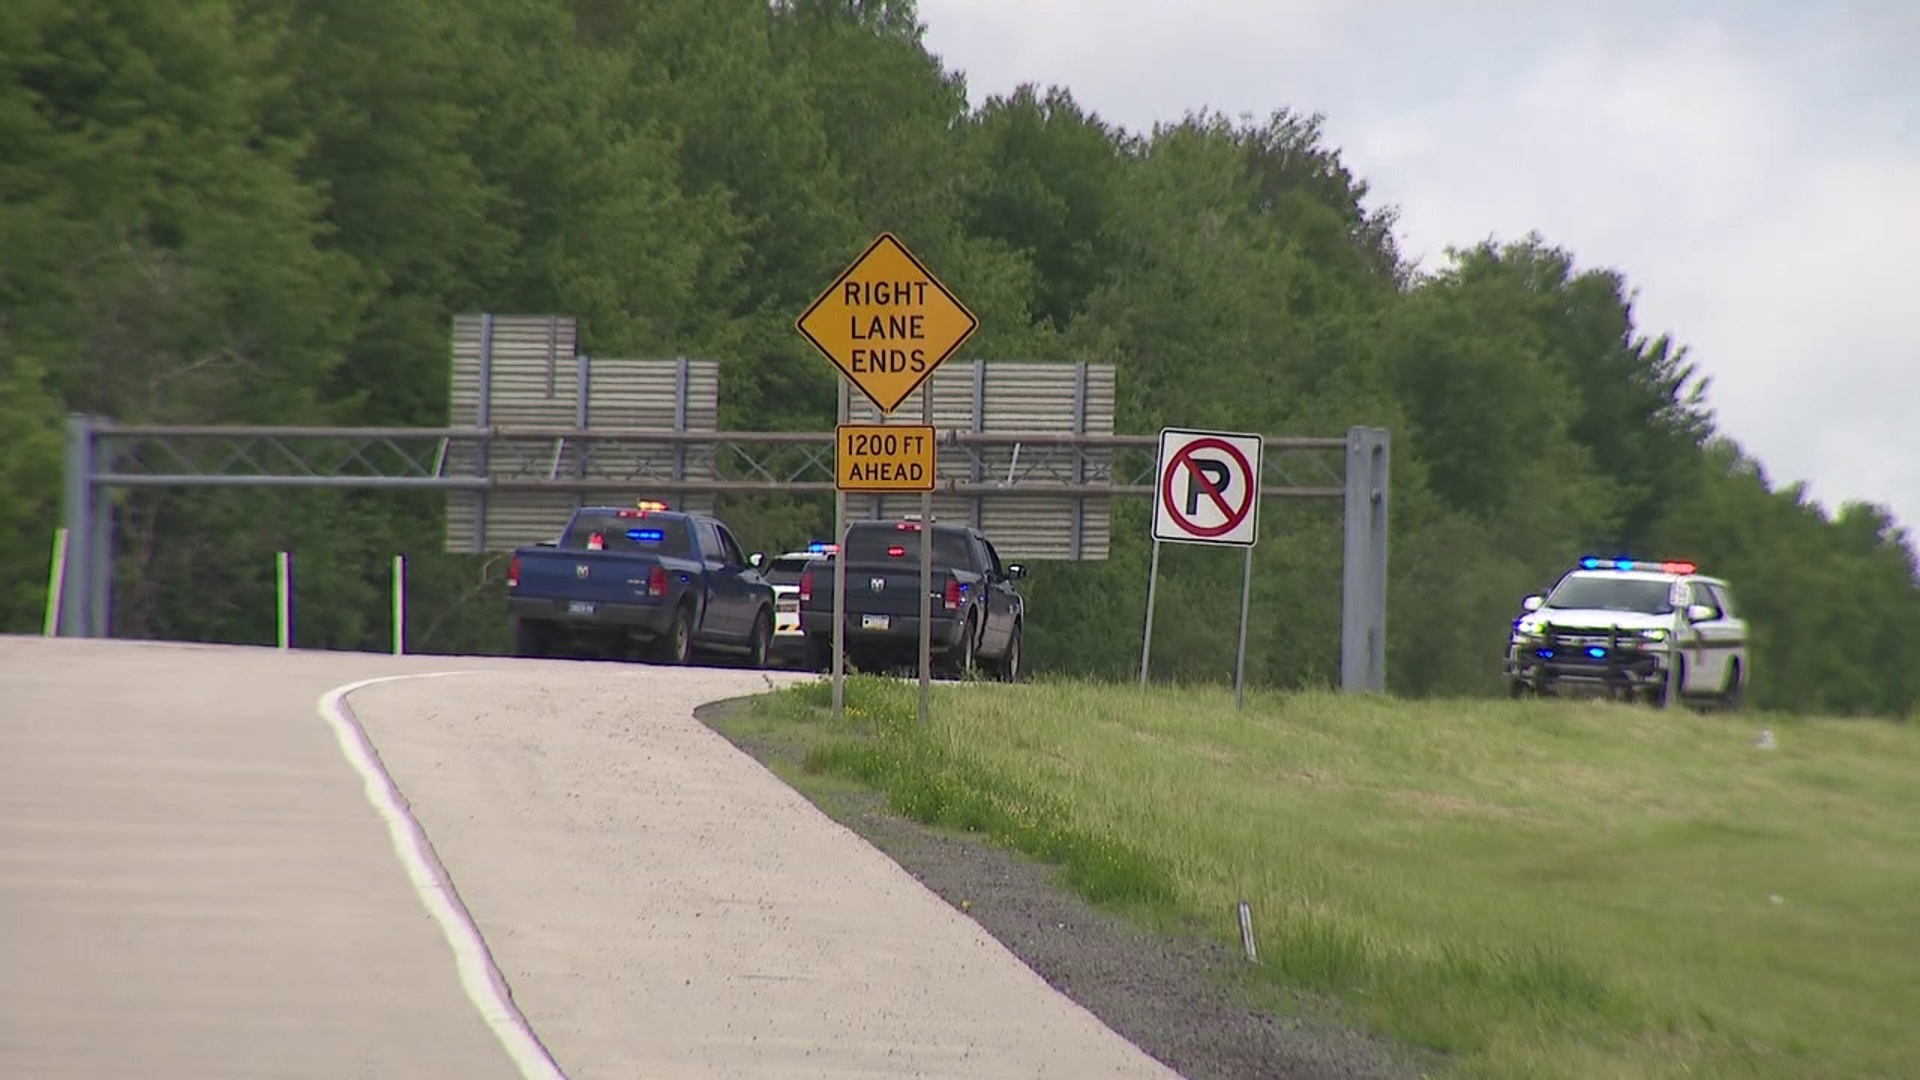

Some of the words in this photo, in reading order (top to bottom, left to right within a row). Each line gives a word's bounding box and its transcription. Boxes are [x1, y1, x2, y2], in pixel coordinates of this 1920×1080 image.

[845, 282, 928, 305] RIGHT
[851, 315, 925, 339] LANE
[851, 349, 926, 373] ENDS
[848, 434, 897, 456] 1200
[903, 435, 924, 455] FT
[849, 463, 924, 481] AHEAD
